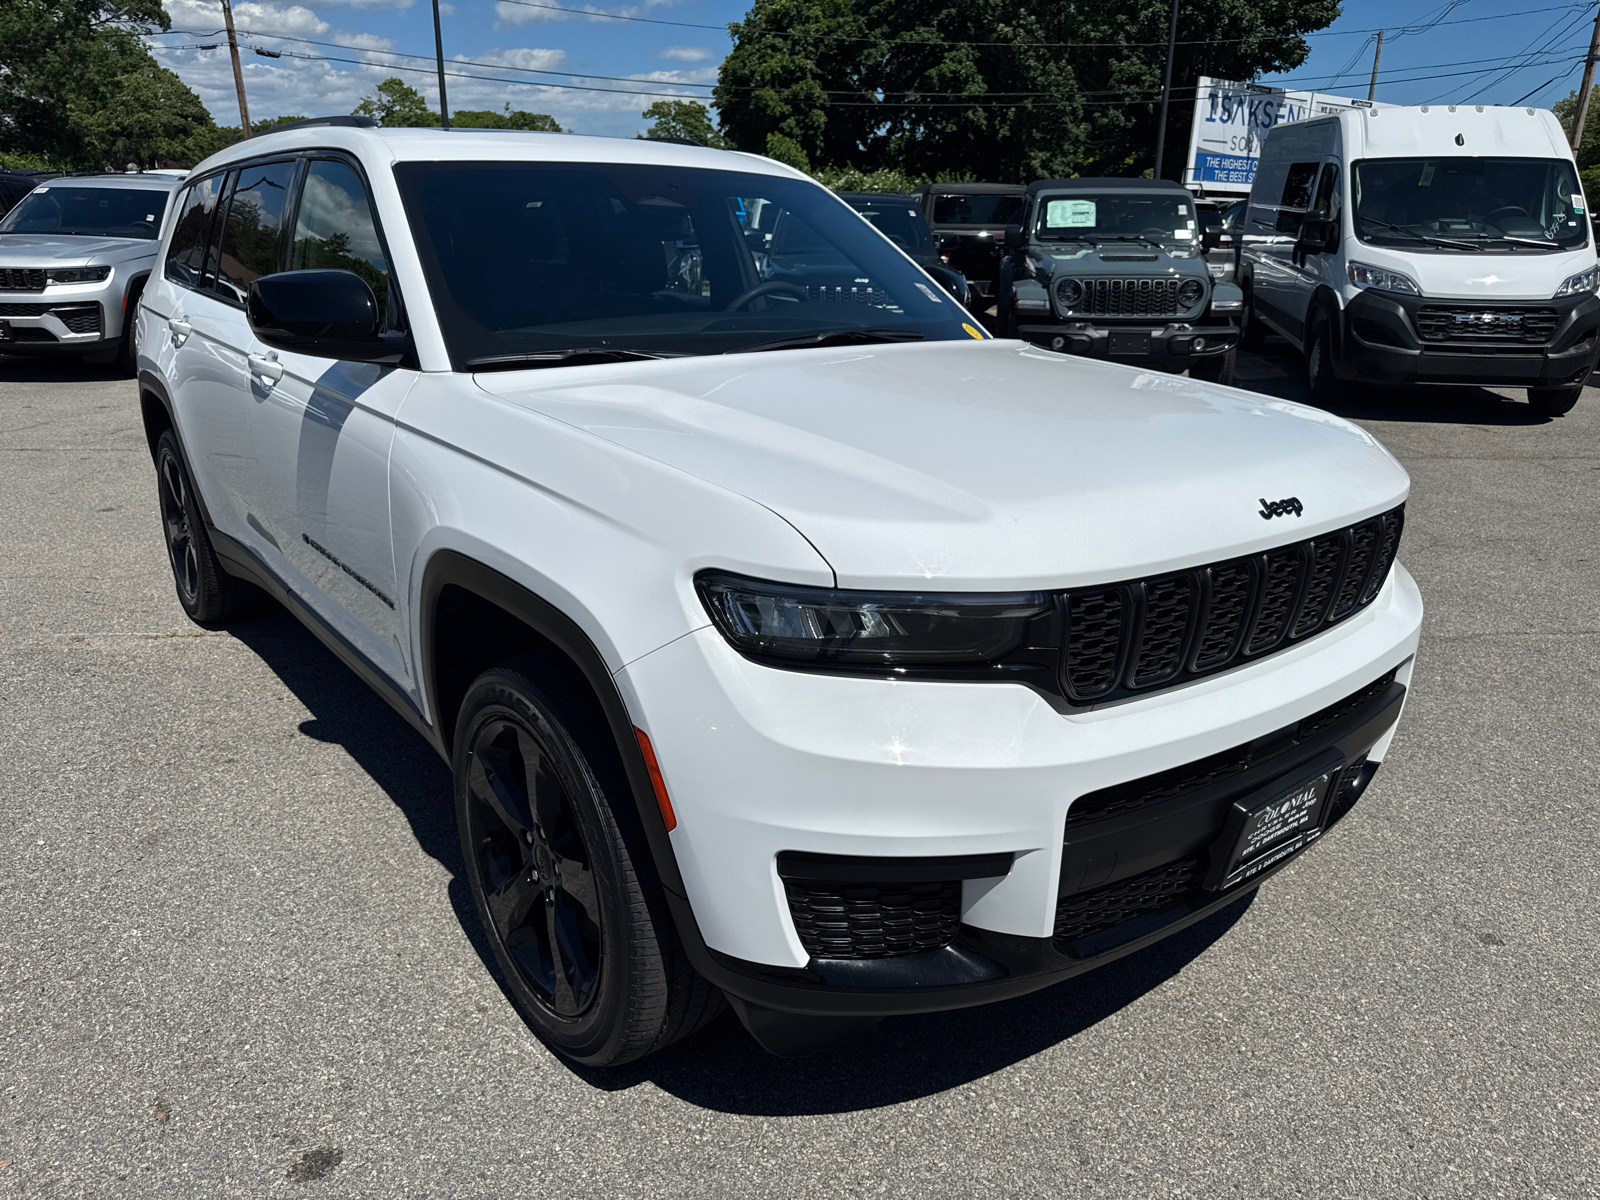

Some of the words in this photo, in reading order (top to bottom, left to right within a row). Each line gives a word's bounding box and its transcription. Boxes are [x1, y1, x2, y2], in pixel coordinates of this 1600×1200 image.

[1206, 156, 1220, 168] THE
[1221, 158, 1252, 170] HIGHEST
[1214, 170, 1228, 181] THE
[1228, 171, 1247, 182] BEST
[1258, 497, 1304, 520] Jeep
[1257, 787, 1316, 827] COLONIAL
[1248, 809, 1297, 839] CHRYSLER
[1251, 822, 1282, 844] DODGE
[1287, 809, 1308, 823] RAM
